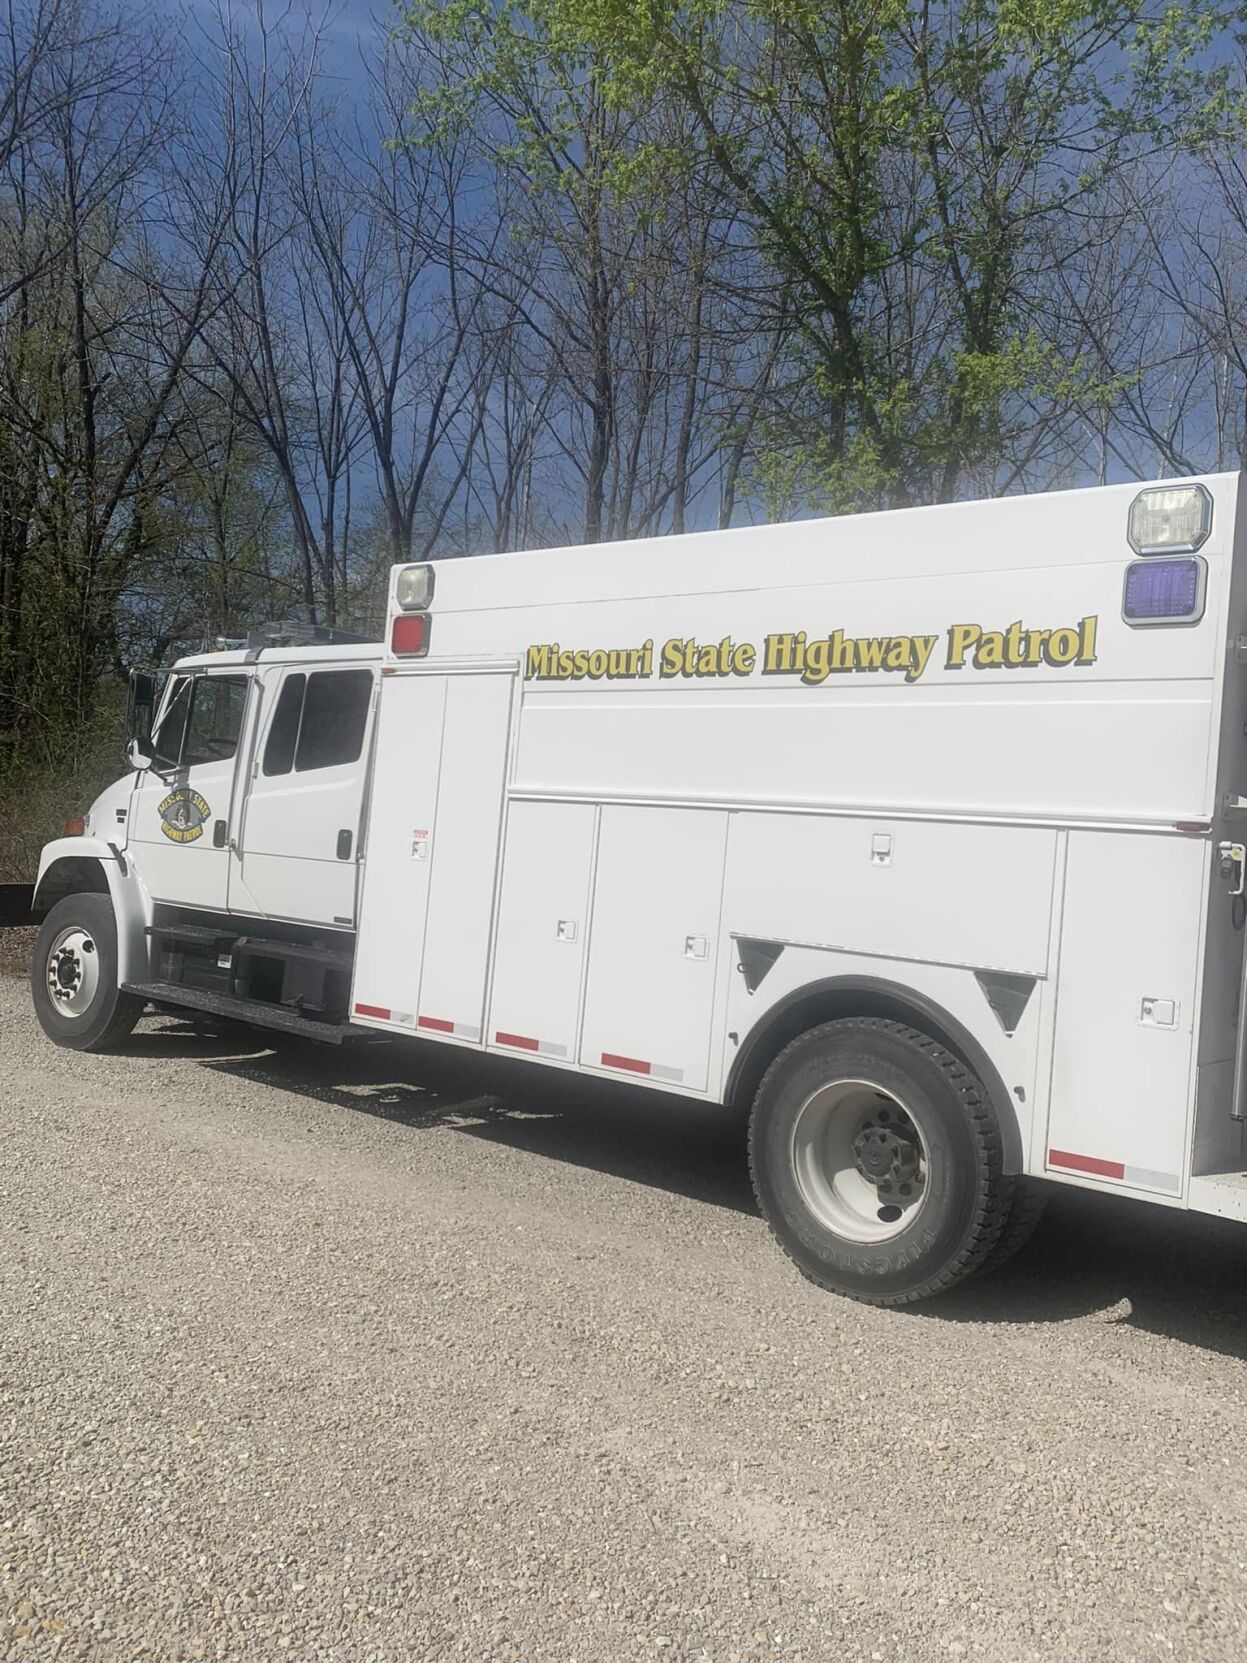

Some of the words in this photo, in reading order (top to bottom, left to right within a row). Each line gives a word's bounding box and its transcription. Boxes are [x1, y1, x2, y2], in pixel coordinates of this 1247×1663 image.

[525, 638, 653, 680] Missouri
[659, 635, 756, 680] State
[761, 628, 938, 685] Highway
[944, 615, 1098, 670] Patrol
